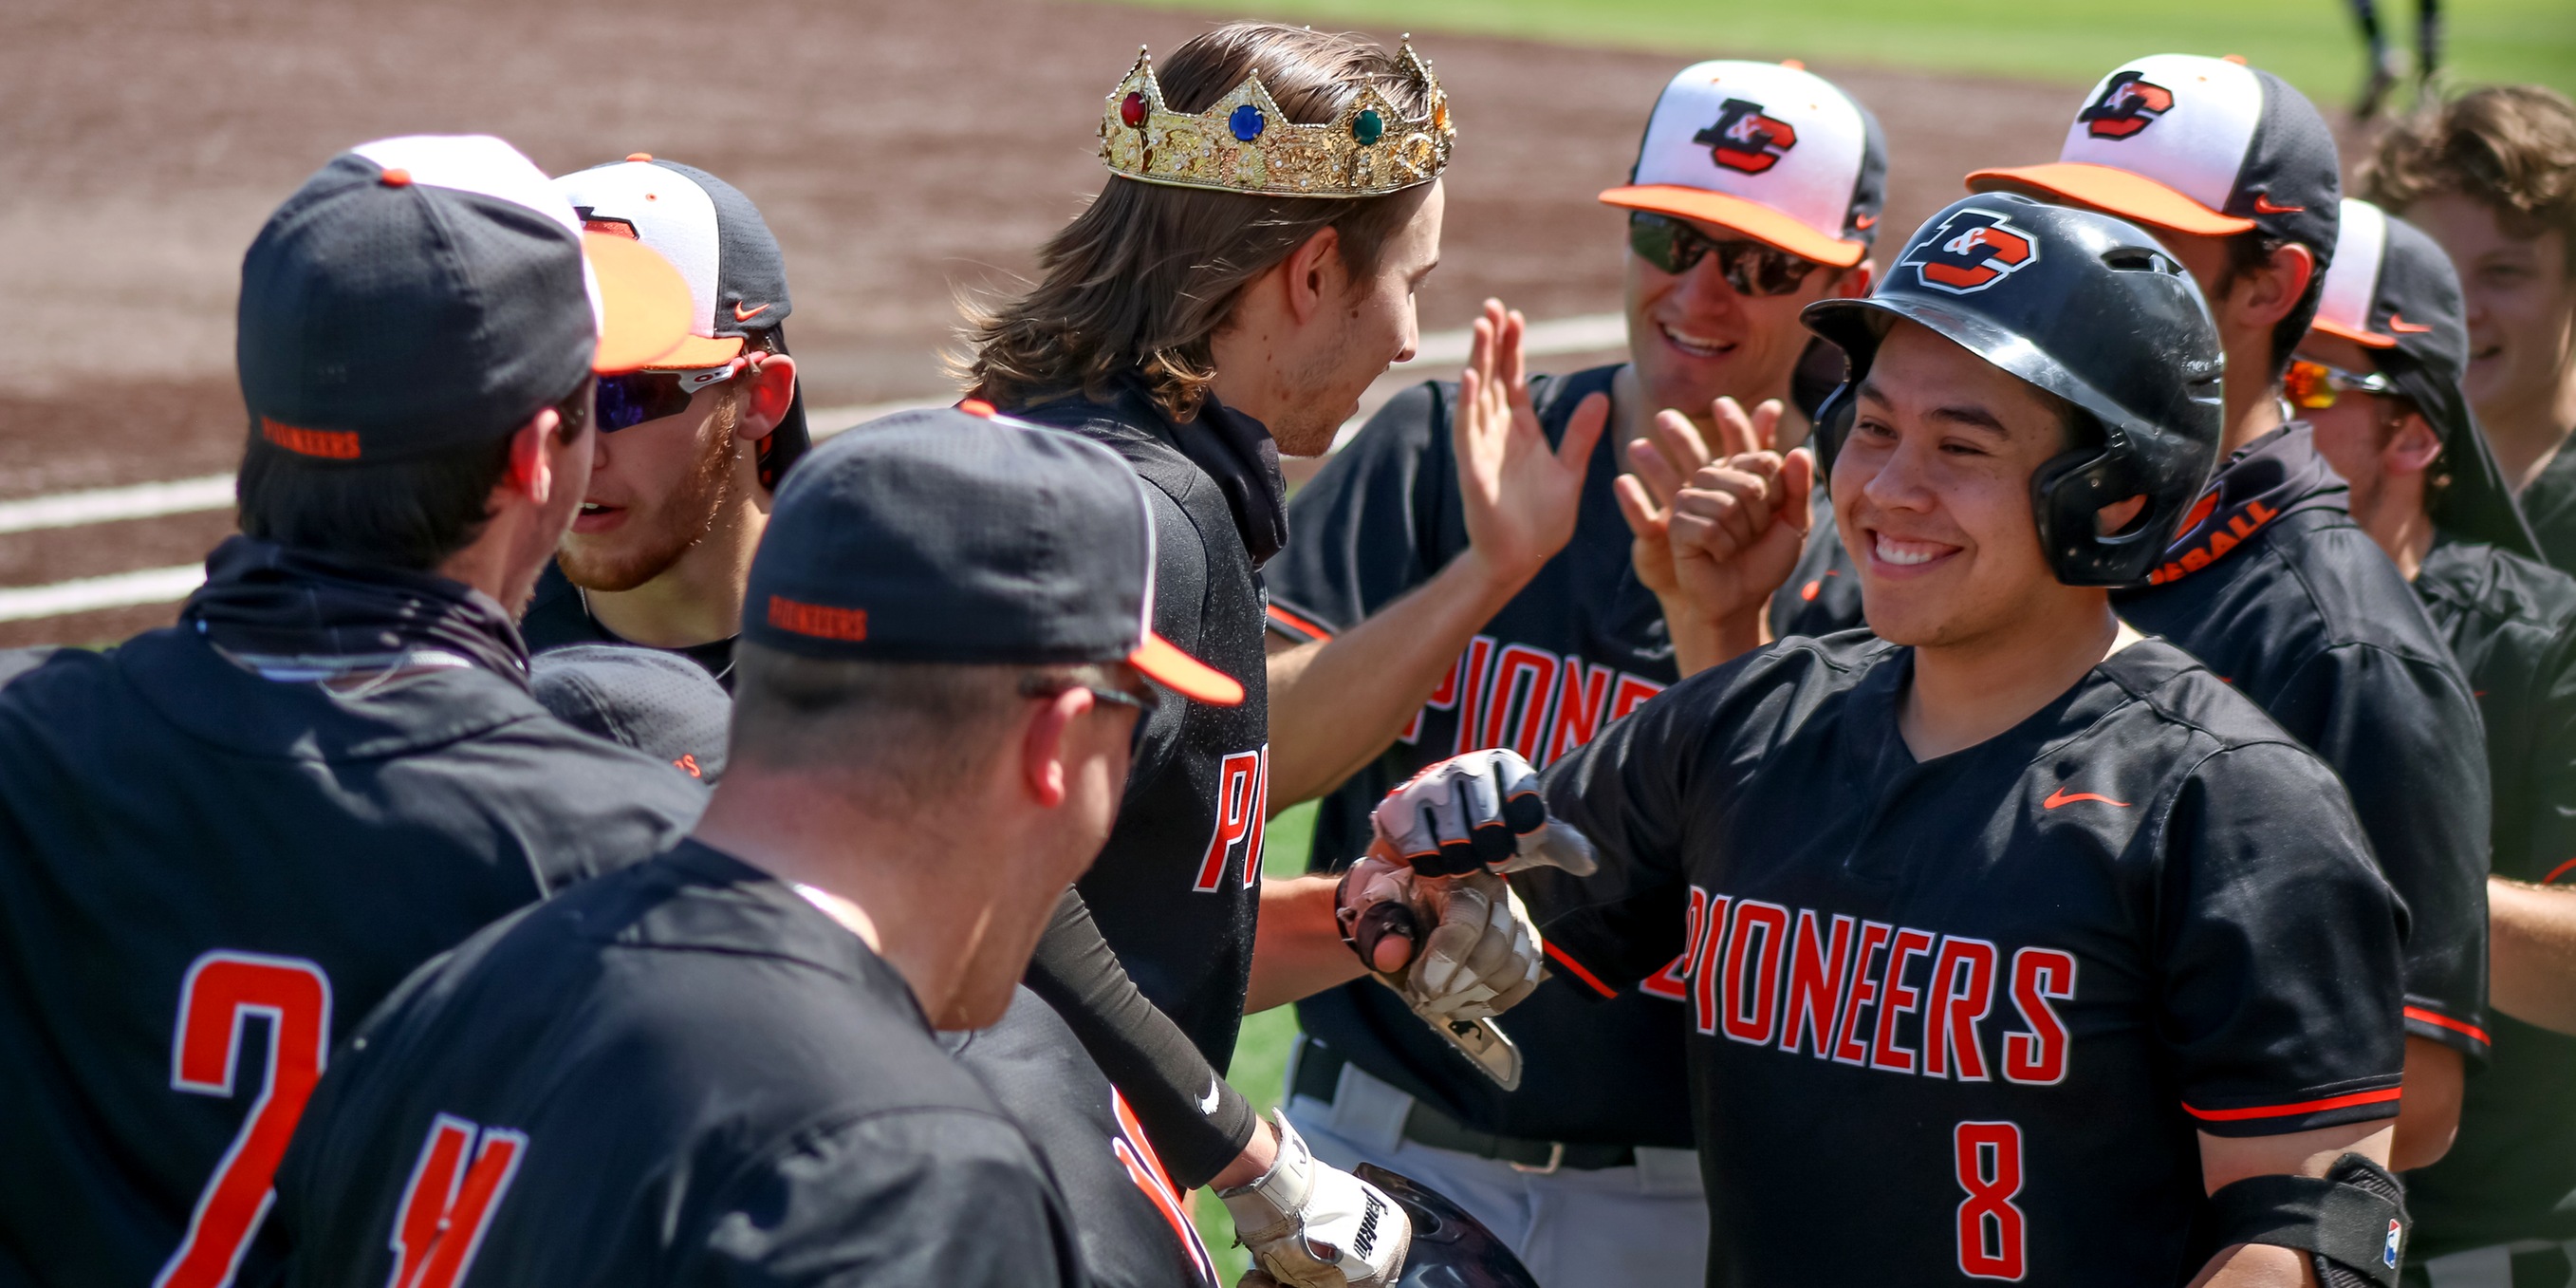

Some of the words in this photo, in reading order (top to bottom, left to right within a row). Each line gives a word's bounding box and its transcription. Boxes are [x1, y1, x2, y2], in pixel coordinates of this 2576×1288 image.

[1693, 98, 1797, 177] L&C
[1900, 207, 2039, 295] L&C
[1954, 1120, 2027, 1282] 8
